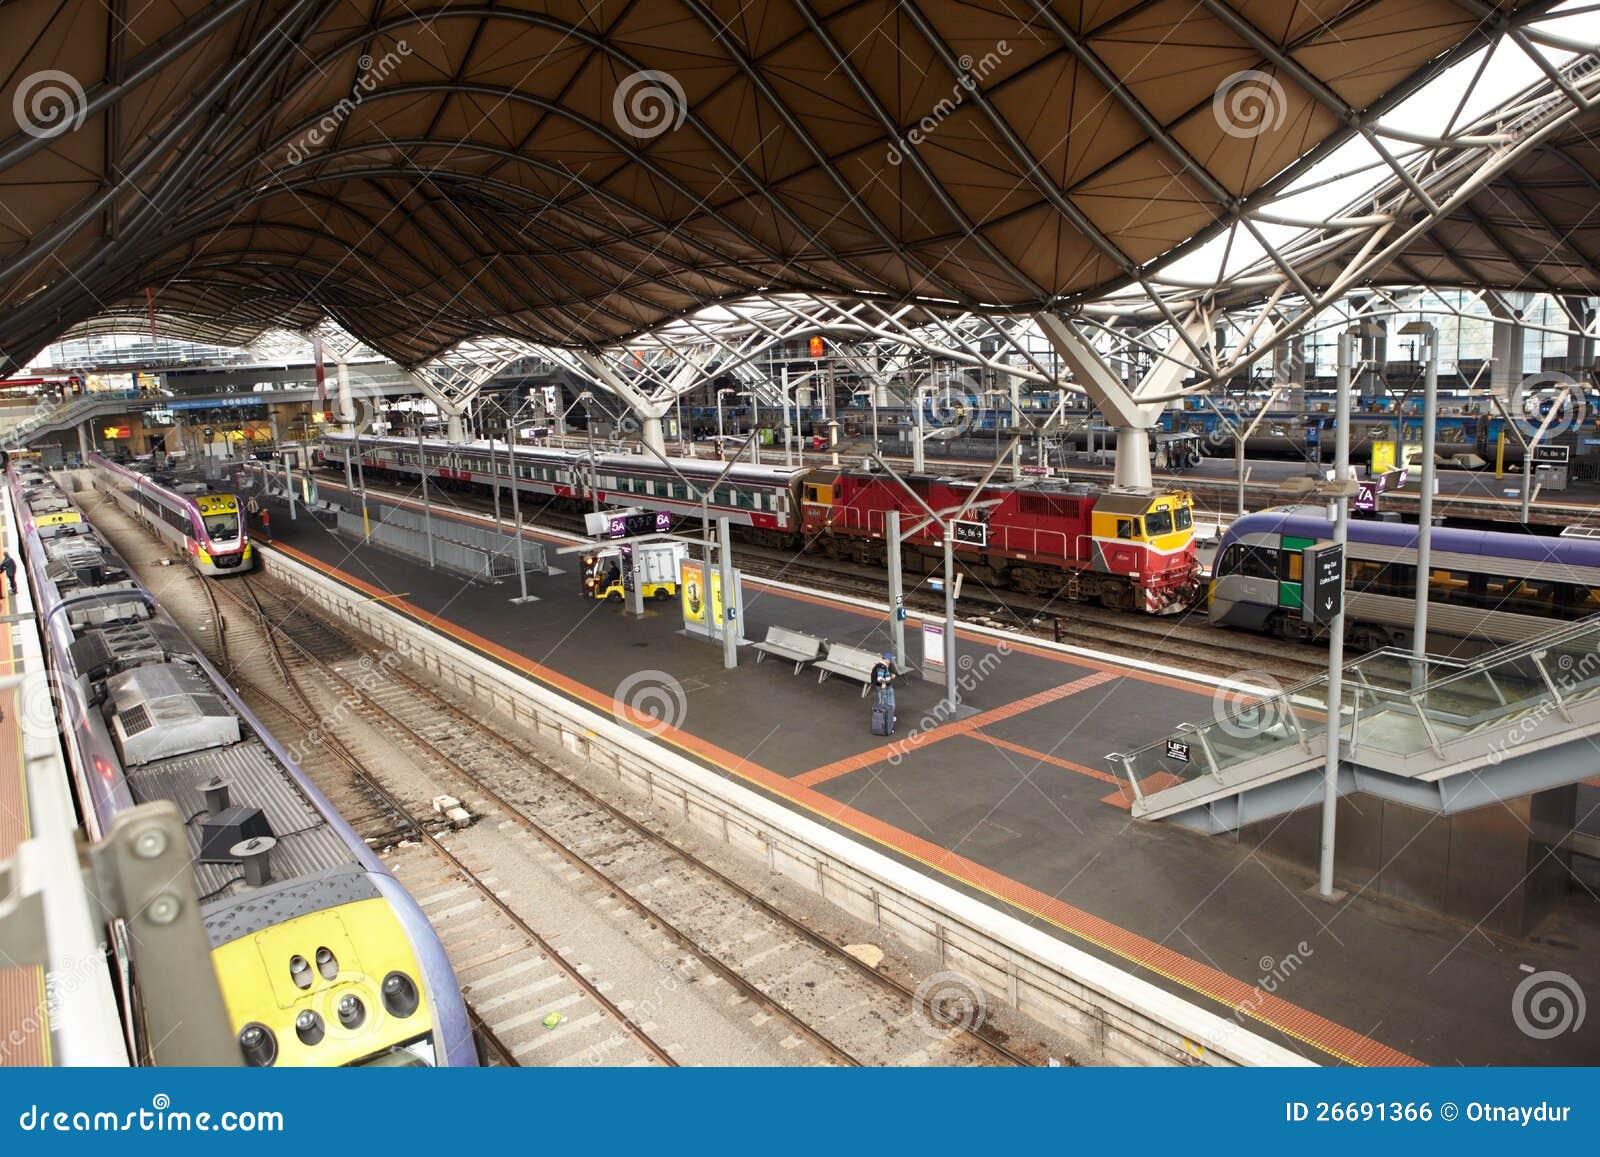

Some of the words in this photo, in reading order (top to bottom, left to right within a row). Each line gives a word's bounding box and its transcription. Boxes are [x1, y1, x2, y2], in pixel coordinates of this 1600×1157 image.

[1358, 486, 1373, 500] 7A
[656, 514, 670, 525] 6A
[611, 520, 625, 532] 5A
[1168, 741, 1188, 752] LIFT
